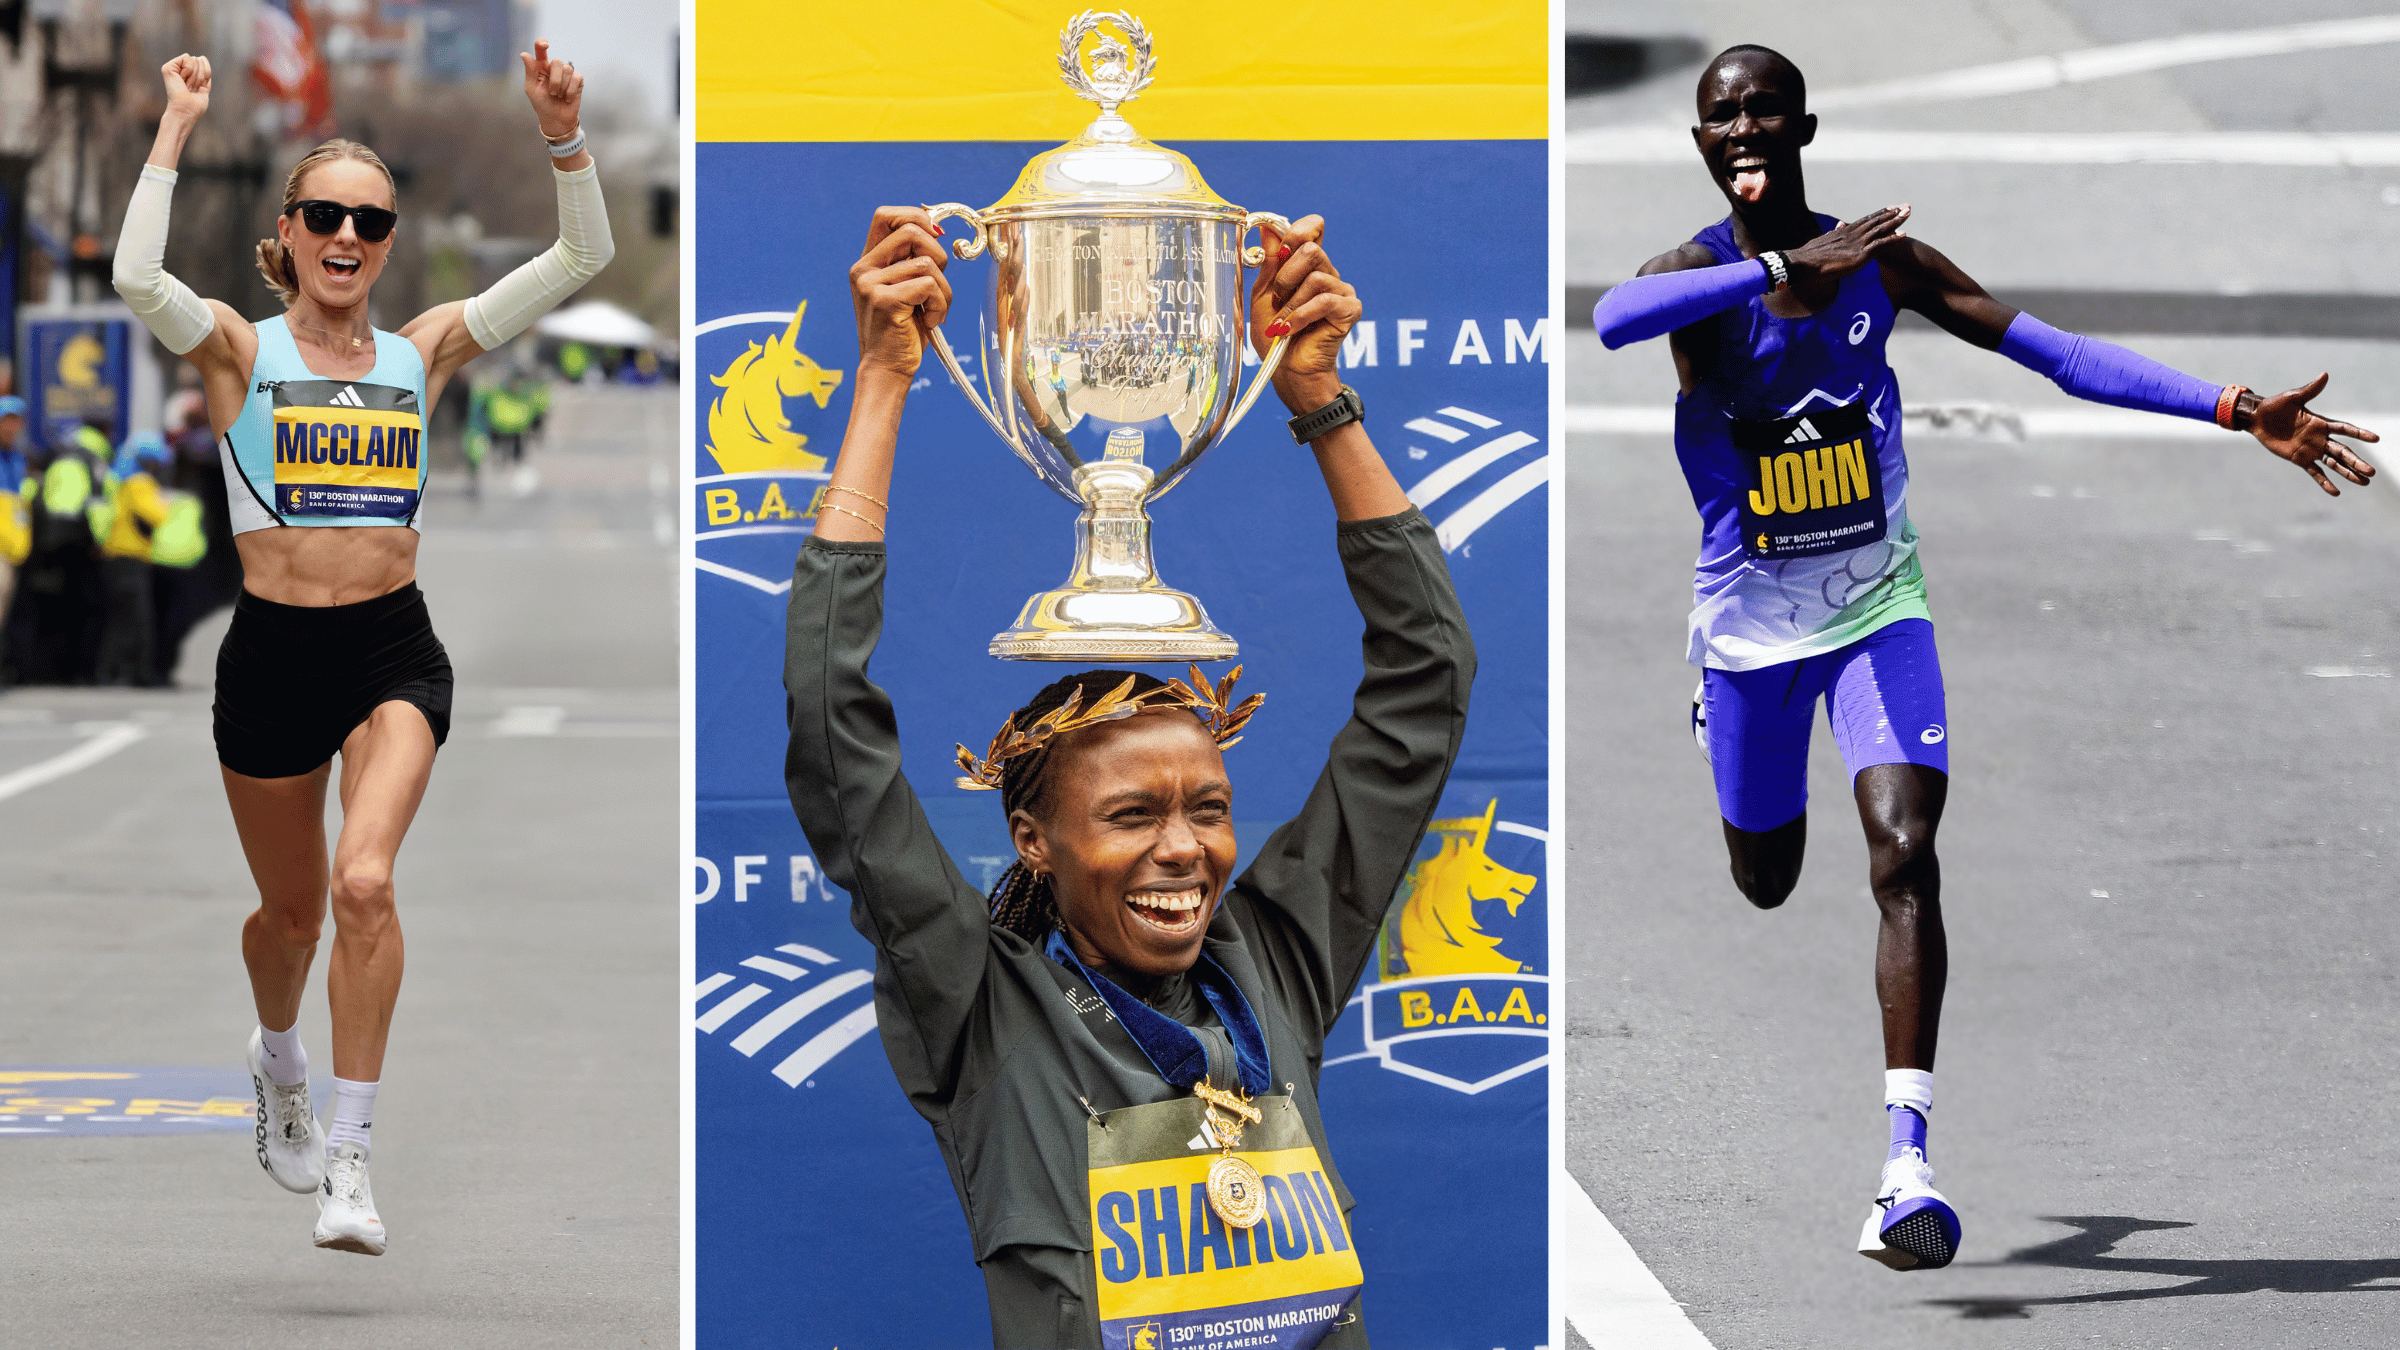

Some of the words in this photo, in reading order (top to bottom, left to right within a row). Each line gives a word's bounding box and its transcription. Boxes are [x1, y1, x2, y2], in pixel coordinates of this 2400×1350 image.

[1105, 279, 1207, 305] BOSTON
[1078, 311, 1226, 338] MARATHON
[275, 422, 420, 469] MCCLAIN
[1748, 438, 1870, 516] JOHN
[327, 492, 358, 502] BOSTON
[360, 493, 405, 504] MARATHON
[1793, 530, 1829, 544] BOSTON
[1829, 520, 1875, 538] MARATHON
[1399, 987, 1547, 1029] B.A.A.
[1205, 1316, 1264, 1339] BOSTON
[1272, 1304, 1341, 1329] MARATHON
[1226, 1334, 1278, 1350] AMERICA
